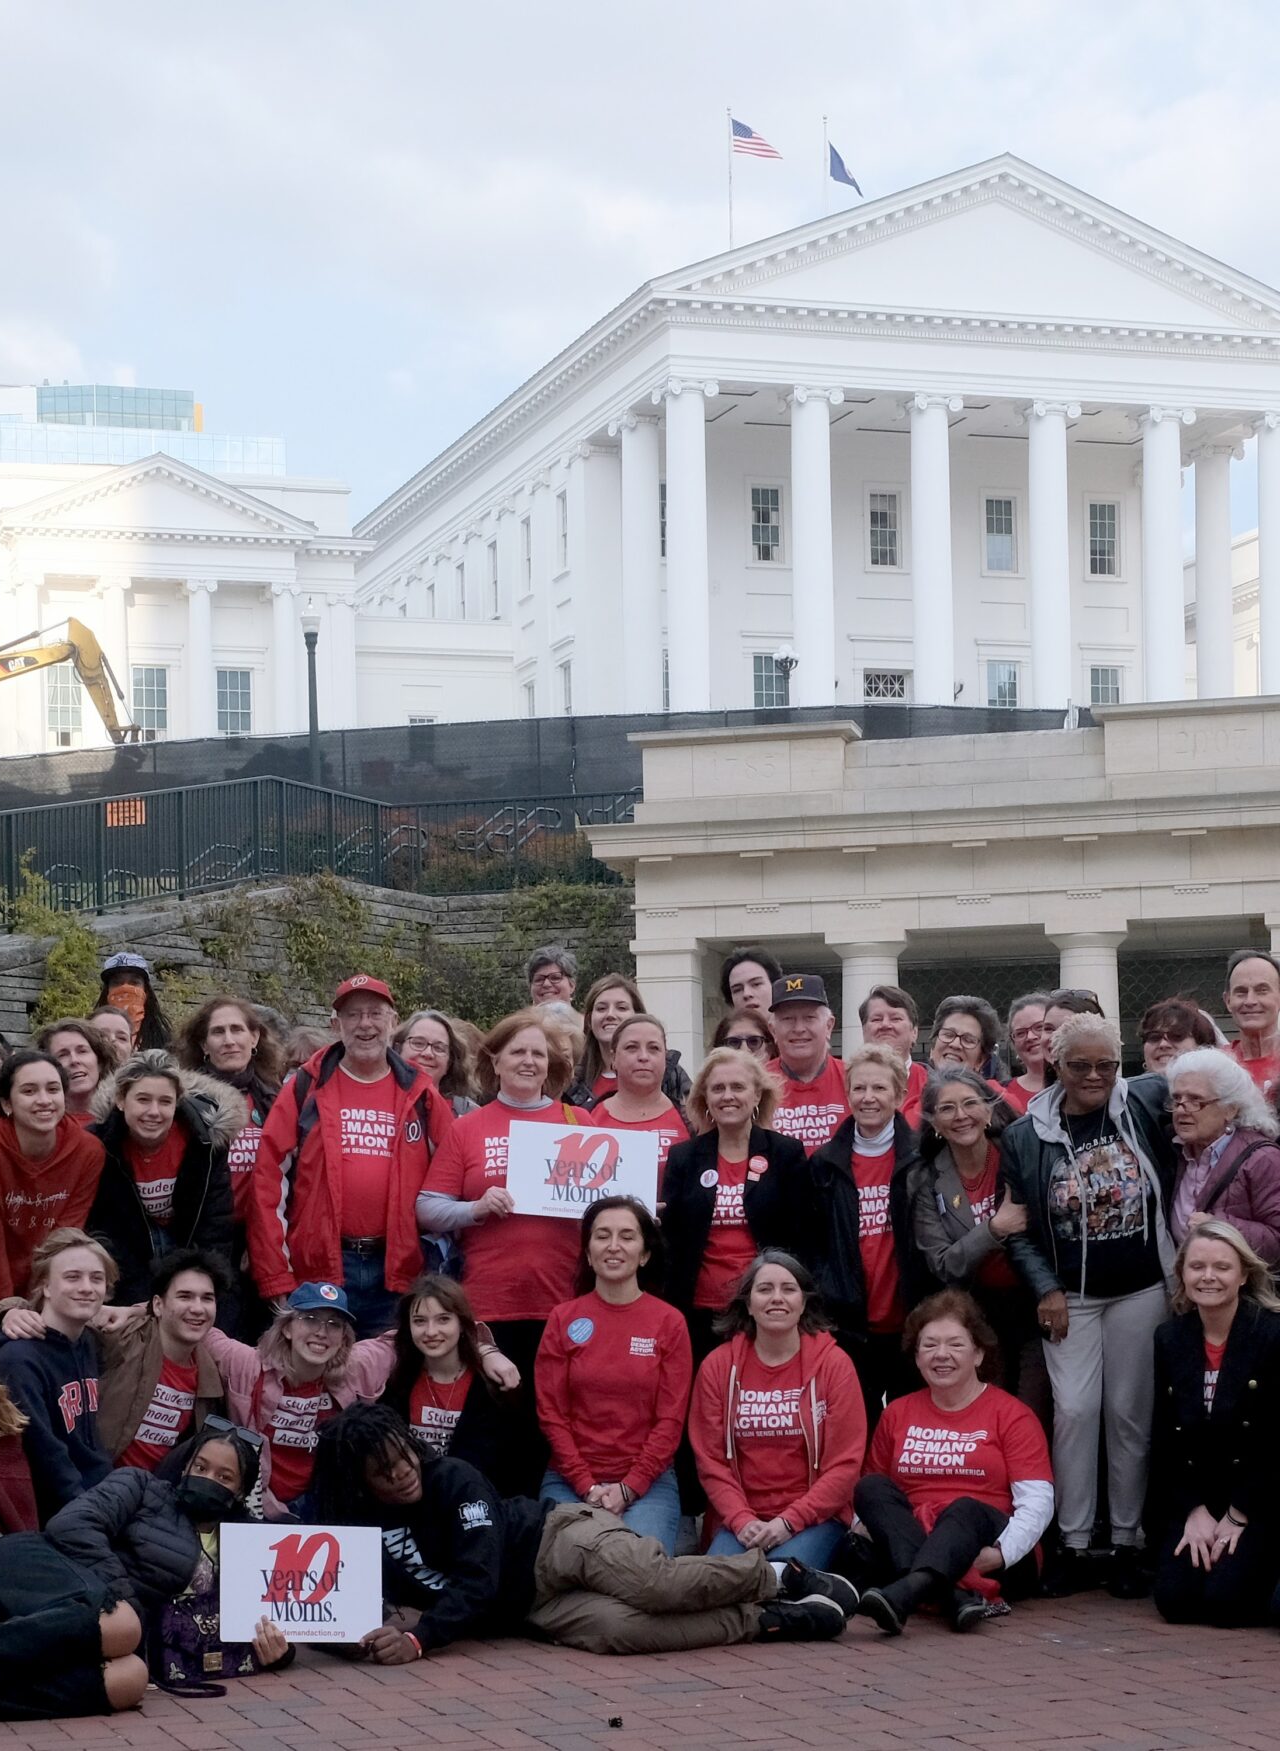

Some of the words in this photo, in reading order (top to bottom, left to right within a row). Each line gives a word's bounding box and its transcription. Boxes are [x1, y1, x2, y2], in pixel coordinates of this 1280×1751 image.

[785, 978, 804, 992] M
[340, 1108, 378, 1122] OMS
[773, 1104, 818, 1119] MOMS
[772, 1114, 838, 1130] DEMAND
[544, 1132, 620, 1188] 10
[544, 1158, 597, 1182] years
[601, 1155, 623, 1182] of
[630, 1346, 654, 1354] ACTION
[736, 1401, 800, 1416] EMAND
[271, 1413, 314, 1429] emand
[426, 1410, 460, 1425] Stude
[277, 1432, 318, 1446] Action
[907, 1425, 960, 1441] MOMS
[903, 1437, 978, 1454] DEMAND
[898, 1451, 966, 1467] ACTION
[897, 1465, 909, 1474] FOR
[910, 1466, 923, 1475] GUN
[924, 1467, 945, 1476] SENSE
[954, 1468, 986, 1477] AMERICA
[260, 1531, 342, 1603] 10
[260, 1569, 318, 1598] years
[321, 1560, 345, 1593] of
[269, 1591, 337, 1623] Moms.
[281, 1629, 346, 1639] demandaction.org
